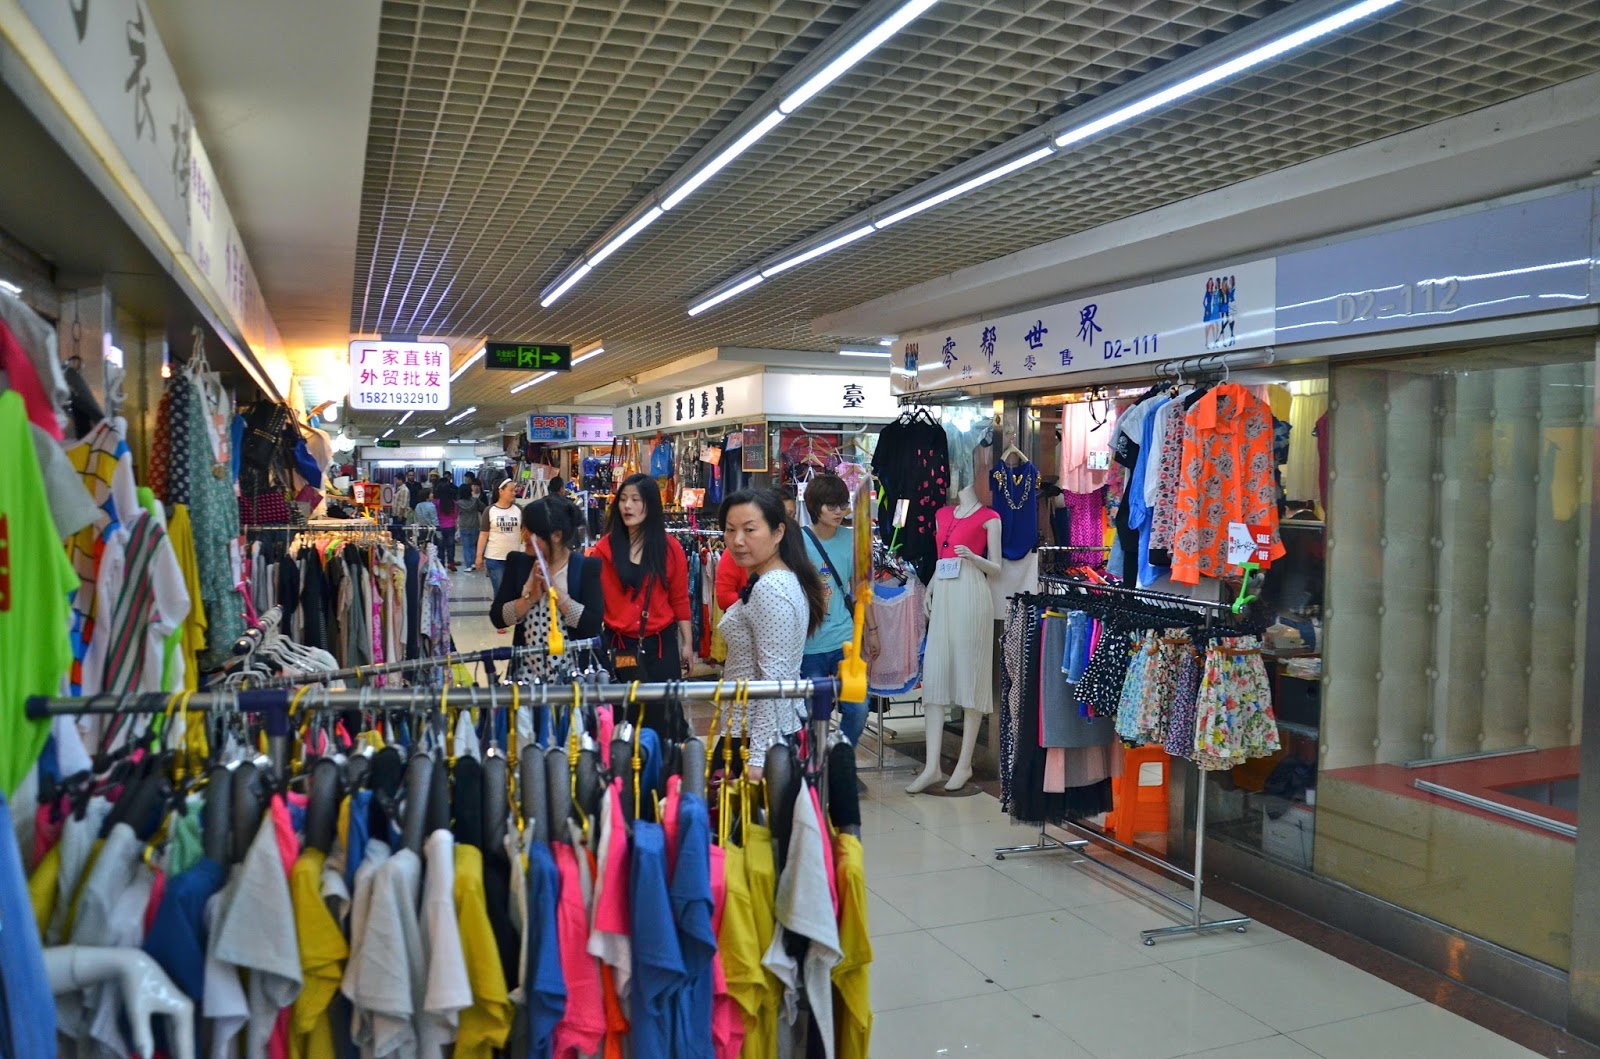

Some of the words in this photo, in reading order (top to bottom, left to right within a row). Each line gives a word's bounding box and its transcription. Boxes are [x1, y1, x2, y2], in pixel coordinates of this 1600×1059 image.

[1336, 278, 1459, 325] D2-112
[1104, 333, 1158, 360] D2-111
[360, 349, 442, 367] 厂家直销
[962, 348, 1073, 379] 批发零售
[360, 369, 441, 387] 外贸批发
[360, 392, 439, 404] 15821932910
[843, 383, 865, 408] 臺
[1256, 533, 1270, 544] SALE
[1258, 551, 1268, 560] OFF
